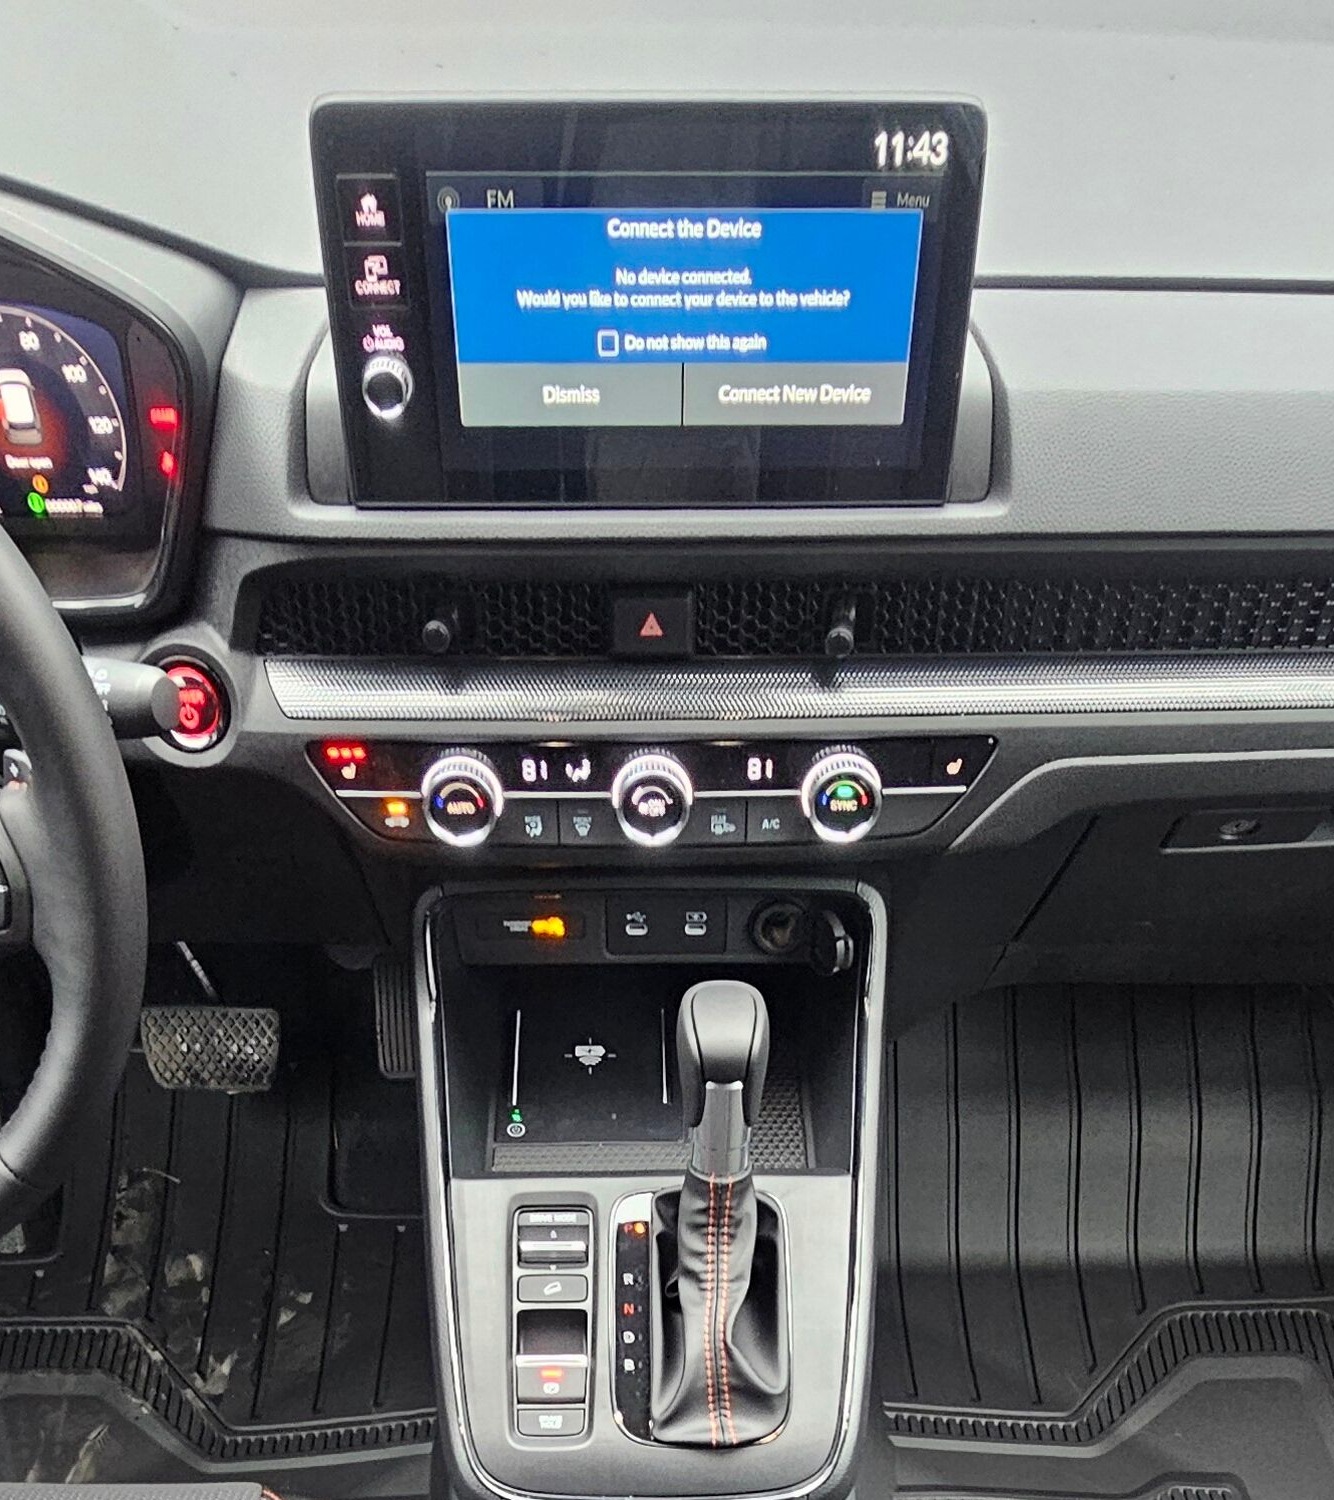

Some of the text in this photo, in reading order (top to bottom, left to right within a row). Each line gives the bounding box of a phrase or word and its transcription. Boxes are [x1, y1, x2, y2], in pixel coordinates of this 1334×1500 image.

[874, 130, 949, 167] 11:43
[486, 189, 514, 208] FM
[897, 191, 930, 208] Menu
[355, 211, 386, 228] HOME
[607, 216, 763, 239] Connect the Device
[616, 266, 752, 285] No device connected.
[354, 279, 401, 296] CONNECT
[517, 289, 851, 311] Would you like to connect your device to the vehicle?
[372, 324, 393, 337] VOL
[18, 330, 41, 351] 80
[374, 336, 405, 351] AUDIO
[624, 332, 767, 353] Do not show this again
[61, 364, 88, 384] 100
[542, 384, 600, 404] Dismiss
[718, 383, 872, 404] Connect New Device
[87, 415, 115, 435] 120
[521, 757, 548, 783] 81
[746, 757, 774, 781] 81
[446, 801, 477, 815] AUTO
[829, 800, 859, 812] SYNC
[761, 818, 781, 831] A/C
[623, 1223, 634, 1234] P
[622, 1272, 634, 1285] R
[623, 1302, 635, 1315] N
[622, 1330, 636, 1344] D
